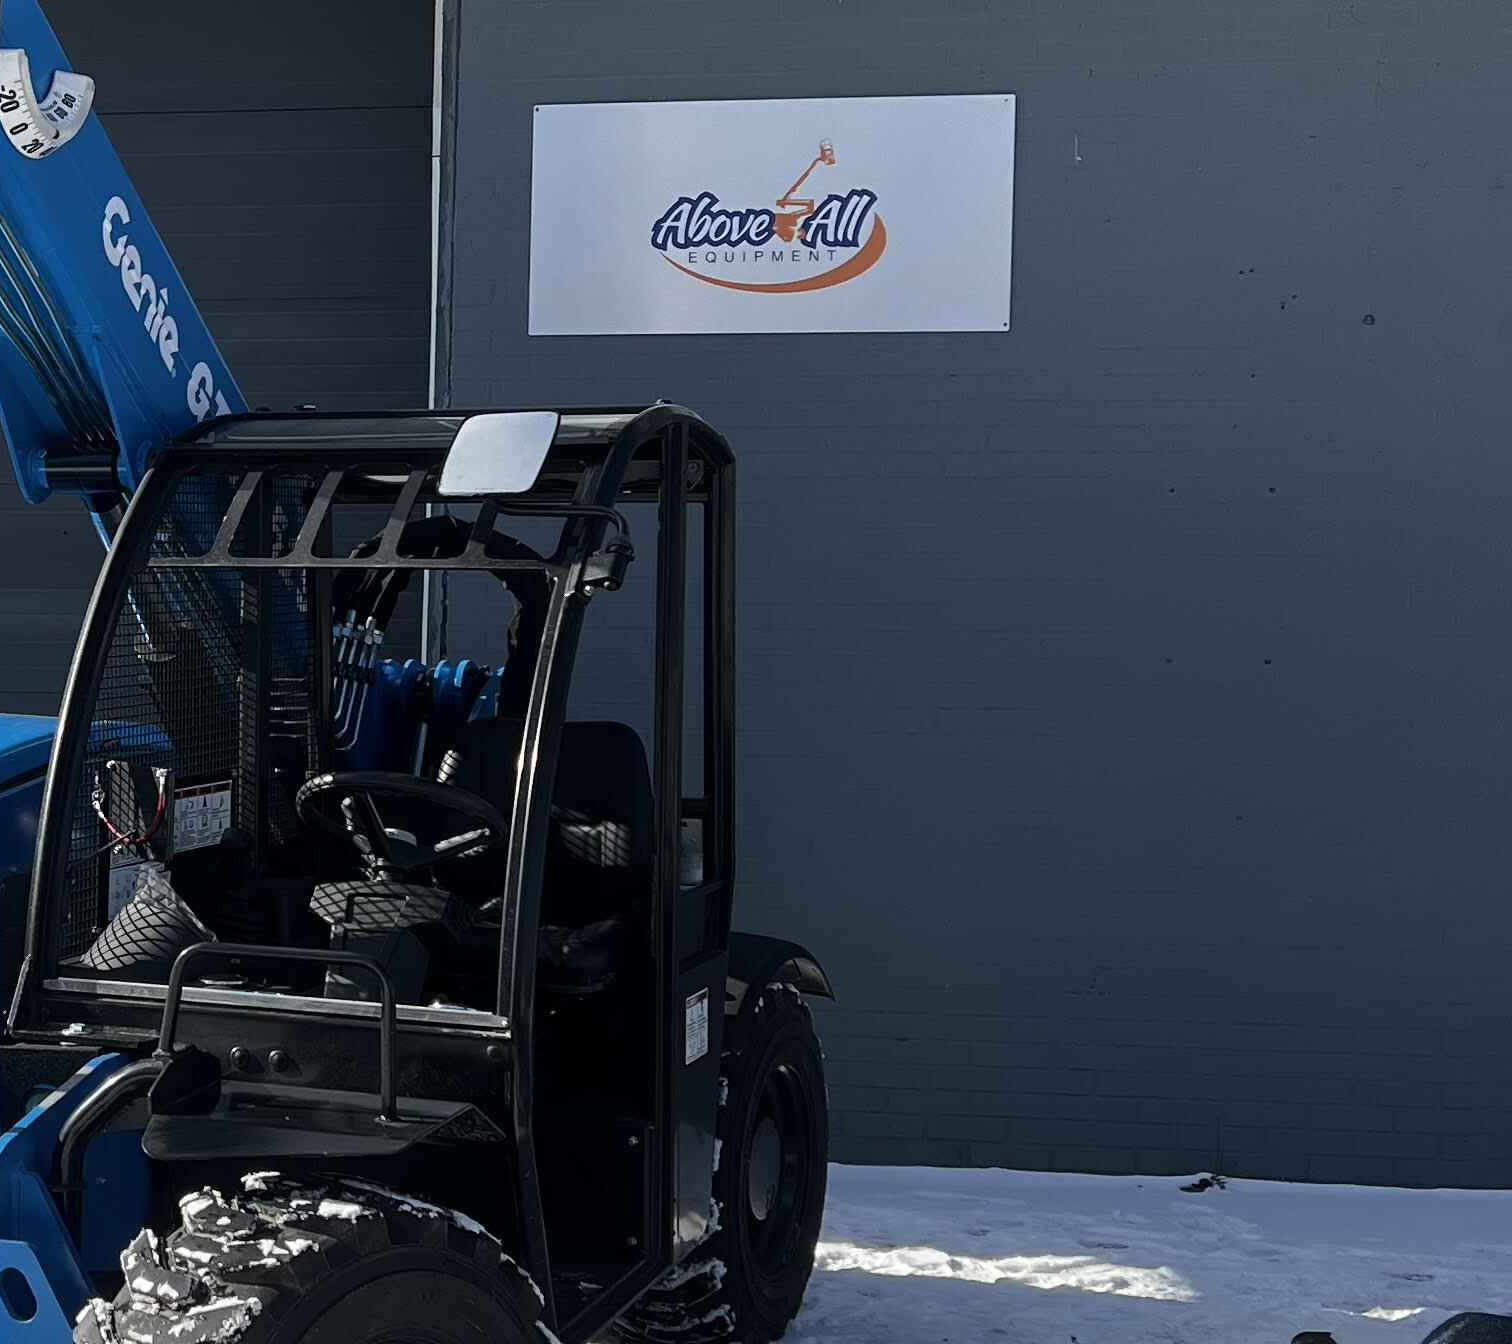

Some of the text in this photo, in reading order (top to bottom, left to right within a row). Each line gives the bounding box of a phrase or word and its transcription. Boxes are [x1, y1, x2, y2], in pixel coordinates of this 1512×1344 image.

[9, 122, 29, 136] 0
[21, 138, 44, 154] 20
[652, 189, 877, 250] Above All
[688, 249, 838, 265] EQUIPMENT
[102, 196, 179, 377] Genie
